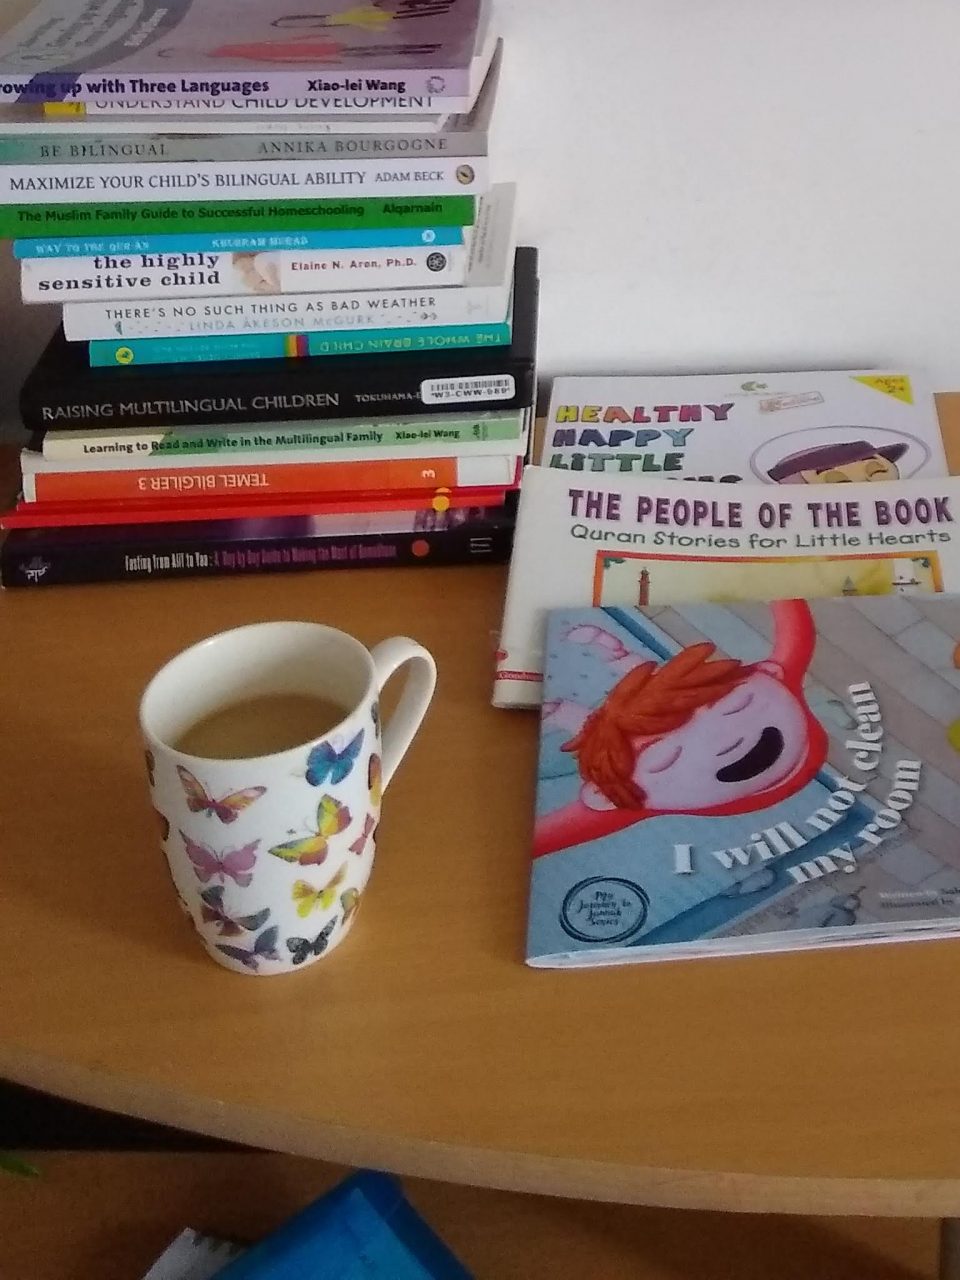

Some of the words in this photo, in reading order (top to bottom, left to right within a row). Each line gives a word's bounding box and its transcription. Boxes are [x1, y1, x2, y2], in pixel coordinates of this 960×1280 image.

[87, 79, 127, 94] with
[129, 78, 177, 94] Three
[181, 78, 270, 97] Languages
[307, 79, 362, 93] Xiao-lei
[365, 79, 406, 95] Wang
[40, 143, 62, 158] BE
[70, 142, 170, 158] BILINGUAL
[257, 140, 328, 155] ANNIKA
[334, 137, 448, 153] BOURGOGNE
[9, 176, 96, 192] MAXIMIZE
[99, 175, 144, 189] YOUR
[148, 172, 211, 189] CHILD'S
[215, 172, 300, 188] BILINGUAL
[304, 170, 367, 186] ABILITY
[374, 171, 411, 184] ADAM
[414, 169, 445, 183] BECK
[17, 209, 42, 223] The
[45, 208, 91, 222] Muslim
[95, 207, 137, 223] Family
[141, 206, 178, 221] Guide
[182, 207, 195, 220] to
[198, 205, 264, 219] Successful
[268, 203, 365, 219] Homeschooling
[93, 255, 132, 269] the
[140, 252, 220, 271] highly
[291, 260, 328, 272] Elaine
[331, 260, 344, 271] N.
[37, 273, 153, 291] sensitive
[160, 270, 221, 287] child
[105, 306, 167, 320] THERE'S
[172, 305, 197, 319] NO
[204, 303, 244, 317] SUCH
[249, 301, 299, 315] THING
[305, 300, 324, 313] AS
[331, 298, 361, 312] BAD
[366, 295, 437, 310] WEATHER
[189, 319, 237, 332] LINDA
[367, 335, 412, 349] BRAIN
[41, 403, 114, 421] RAISING
[119, 397, 247, 419] MULTILINGUAL
[251, 392, 340, 410] CHILDREN
[554, 402, 736, 424] HEALTHY
[82, 441, 135, 455] Learning
[136, 441, 149, 453] to
[150, 439, 180, 452] Read
[182, 438, 202, 450] and
[206, 436, 239, 449] Write
[240, 436, 251, 448] in
[252, 435, 273, 447] the
[274, 431, 344, 446] Multilingual
[345, 430, 384, 445] Family
[395, 429, 432, 441] Xiao-lei
[433, 428, 461, 441] Wang
[551, 427, 696, 448] HAPPY
[548, 451, 686, 473] LITTLE
[137, 476, 147, 491] 3
[150, 473, 216, 492] BİLGİLER
[218, 471, 269, 488] TEMEL
[567, 488, 623, 521] THE
[636, 494, 744, 529] PEOPLE
[757, 501, 793, 529] OF
[806, 501, 863, 528] THE
[874, 495, 956, 526] BOOK
[569, 522, 646, 545] Quran
[652, 530, 742, 549] Stories
[748, 532, 788, 549] for
[795, 532, 862, 549] Little
[867, 528, 953, 547] Hearts
[672, 842, 694, 875] I
[711, 821, 809, 871] will
[804, 776, 868, 832] not
[844, 680, 885, 773] clean
[785, 841, 859, 885] my
[857, 758, 923, 846] room
